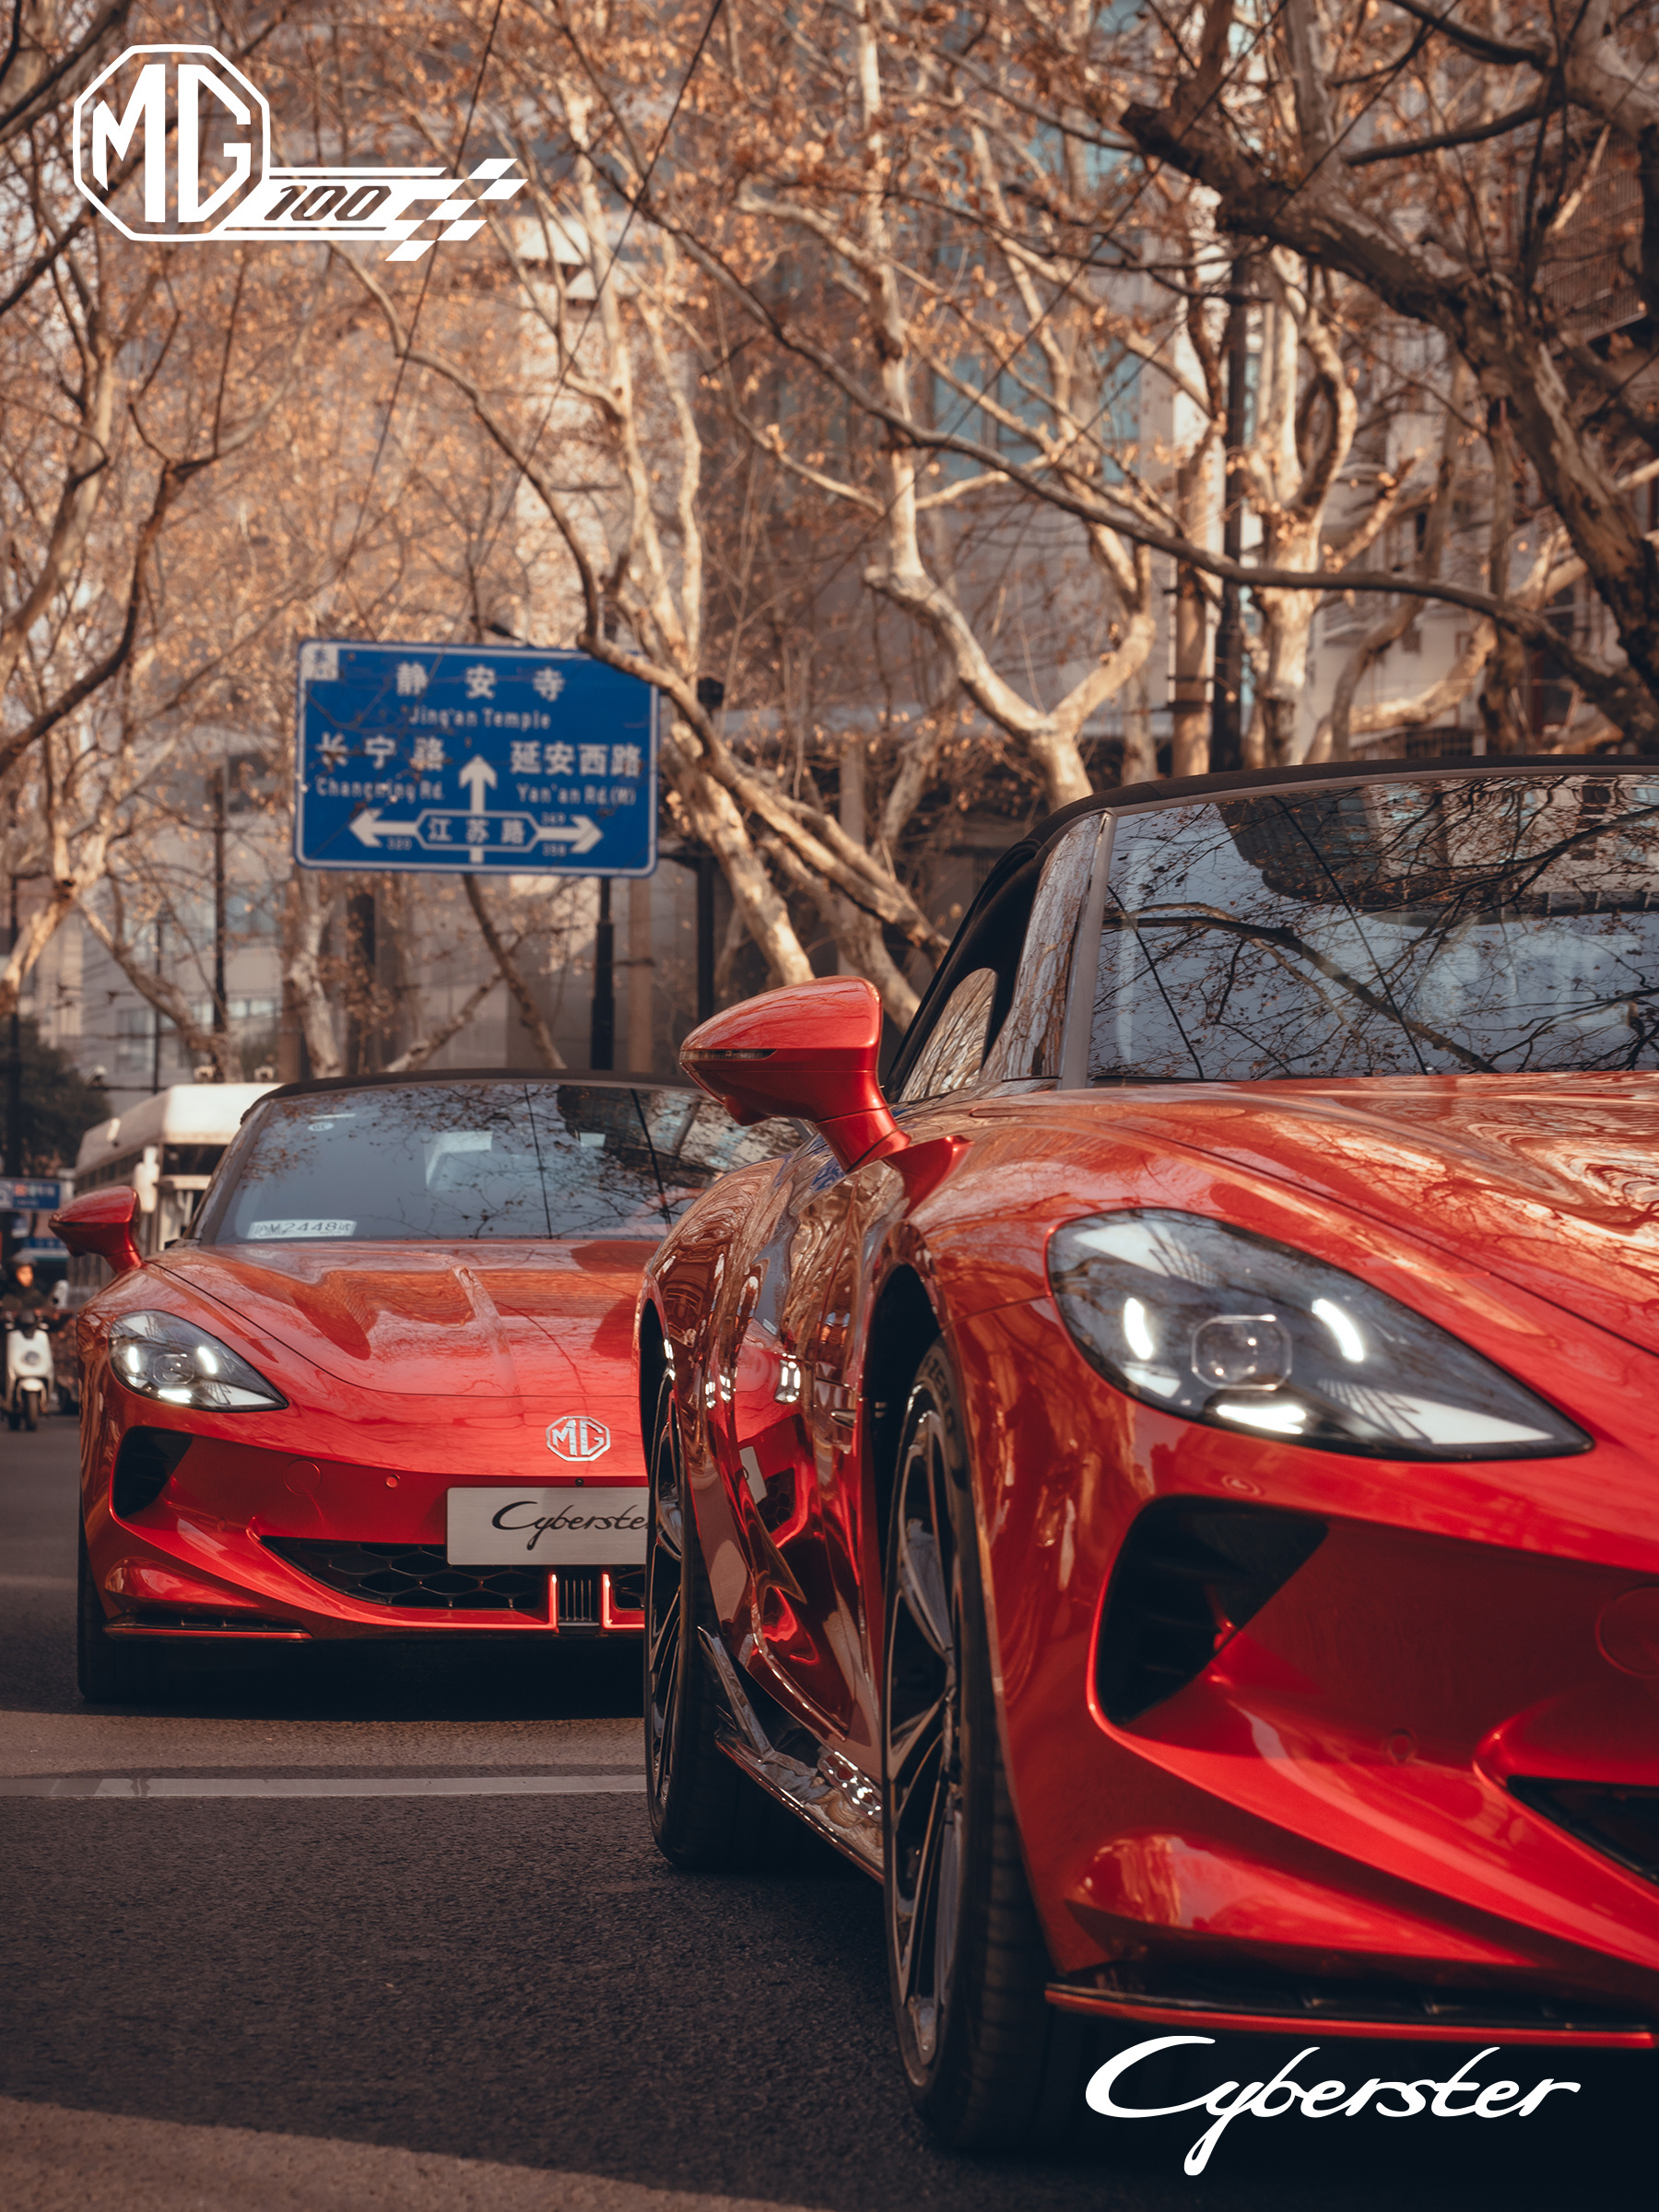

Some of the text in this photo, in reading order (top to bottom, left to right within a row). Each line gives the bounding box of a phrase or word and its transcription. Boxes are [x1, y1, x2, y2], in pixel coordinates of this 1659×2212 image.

[395, 660, 566, 702] 静安寺
[409, 704, 551, 732] Jing'an Temple
[315, 731, 446, 772] 长宁路
[510, 739, 642, 778] 延安西路
[516, 782, 582, 805] Yan'an
[427, 817, 526, 845] 江苏路
[552, 1419, 605, 1456] MG
[492, 1500, 649, 1550] Cyberste
